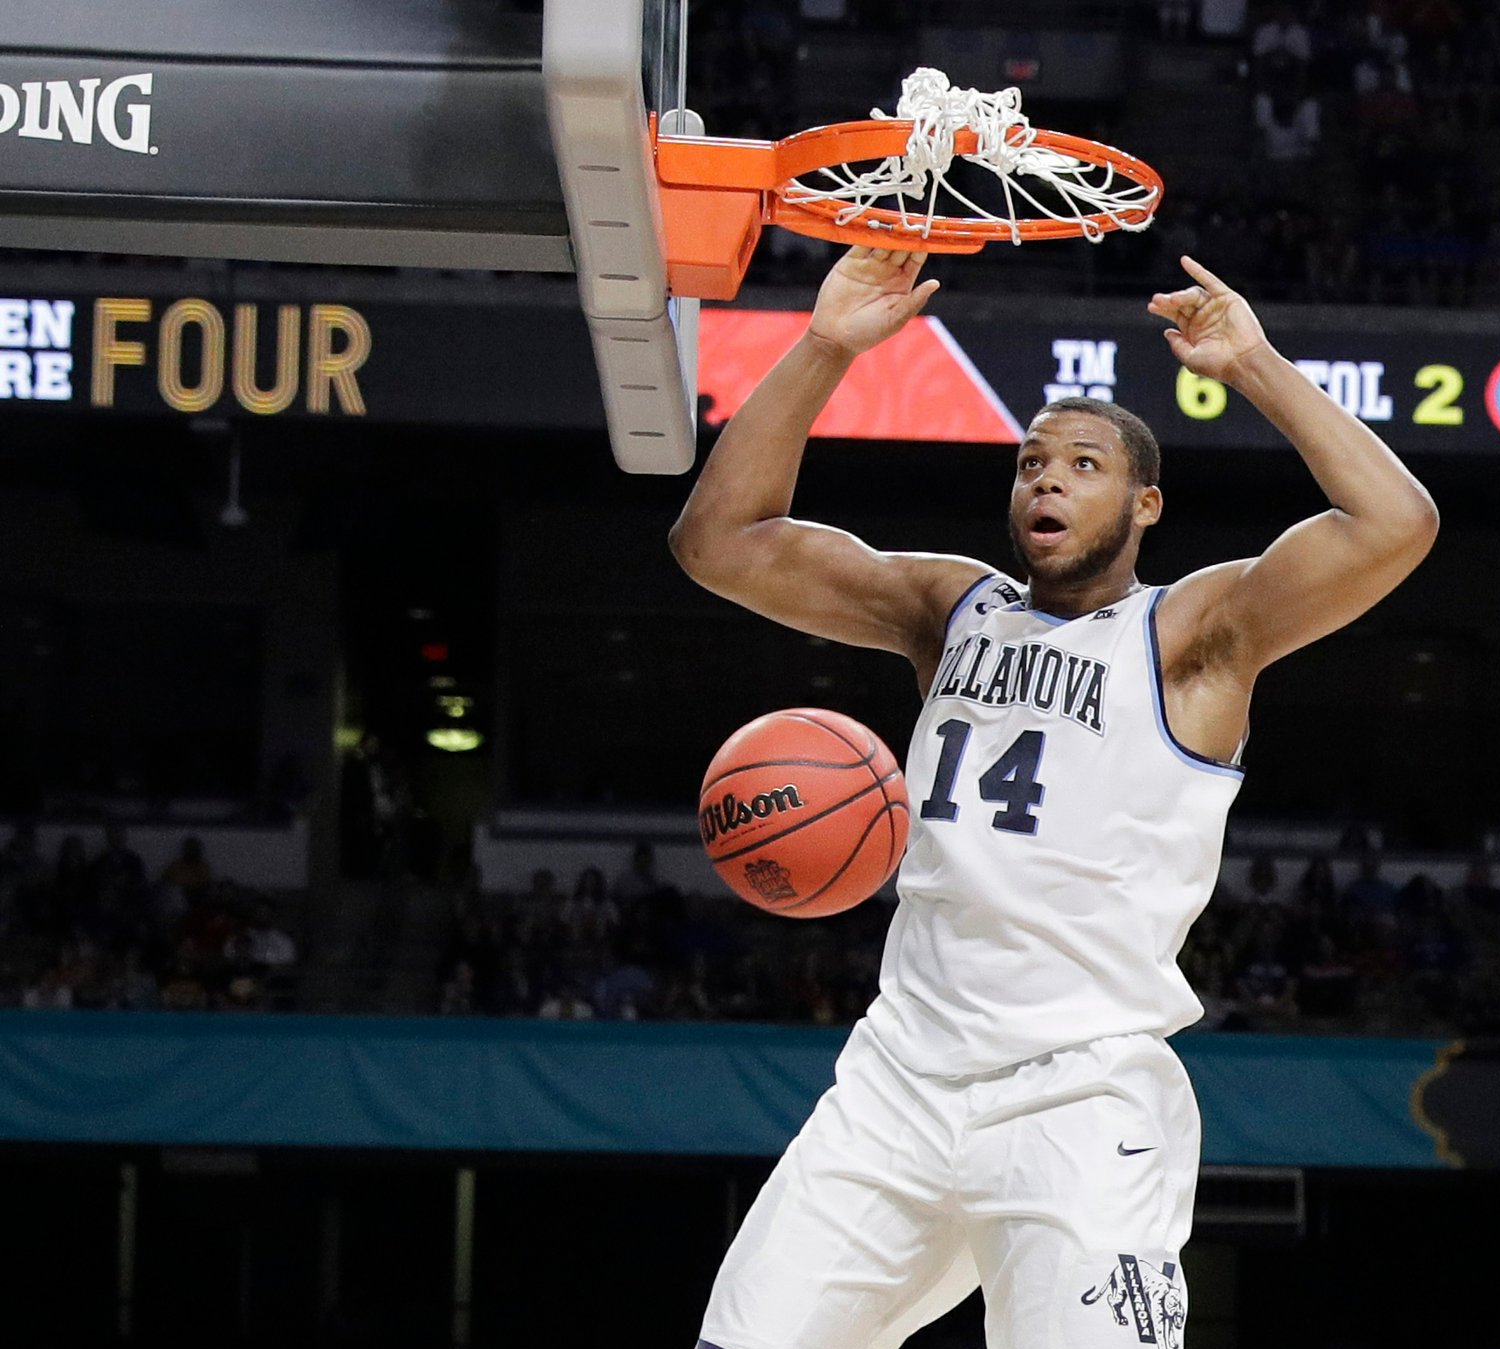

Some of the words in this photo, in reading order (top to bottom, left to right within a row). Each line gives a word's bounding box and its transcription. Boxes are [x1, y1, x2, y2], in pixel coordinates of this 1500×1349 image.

[91, 297, 372, 416] FOUR
[1051, 339, 1118, 386] TM
[1175, 365, 1228, 420] 6
[1412, 363, 1465, 425] 2
[931, 634, 1109, 737] ILLANOVA
[920, 718, 1046, 836] 14
[701, 783, 805, 845] Wilson
[1124, 1261, 1152, 1338] VILLANOVA
